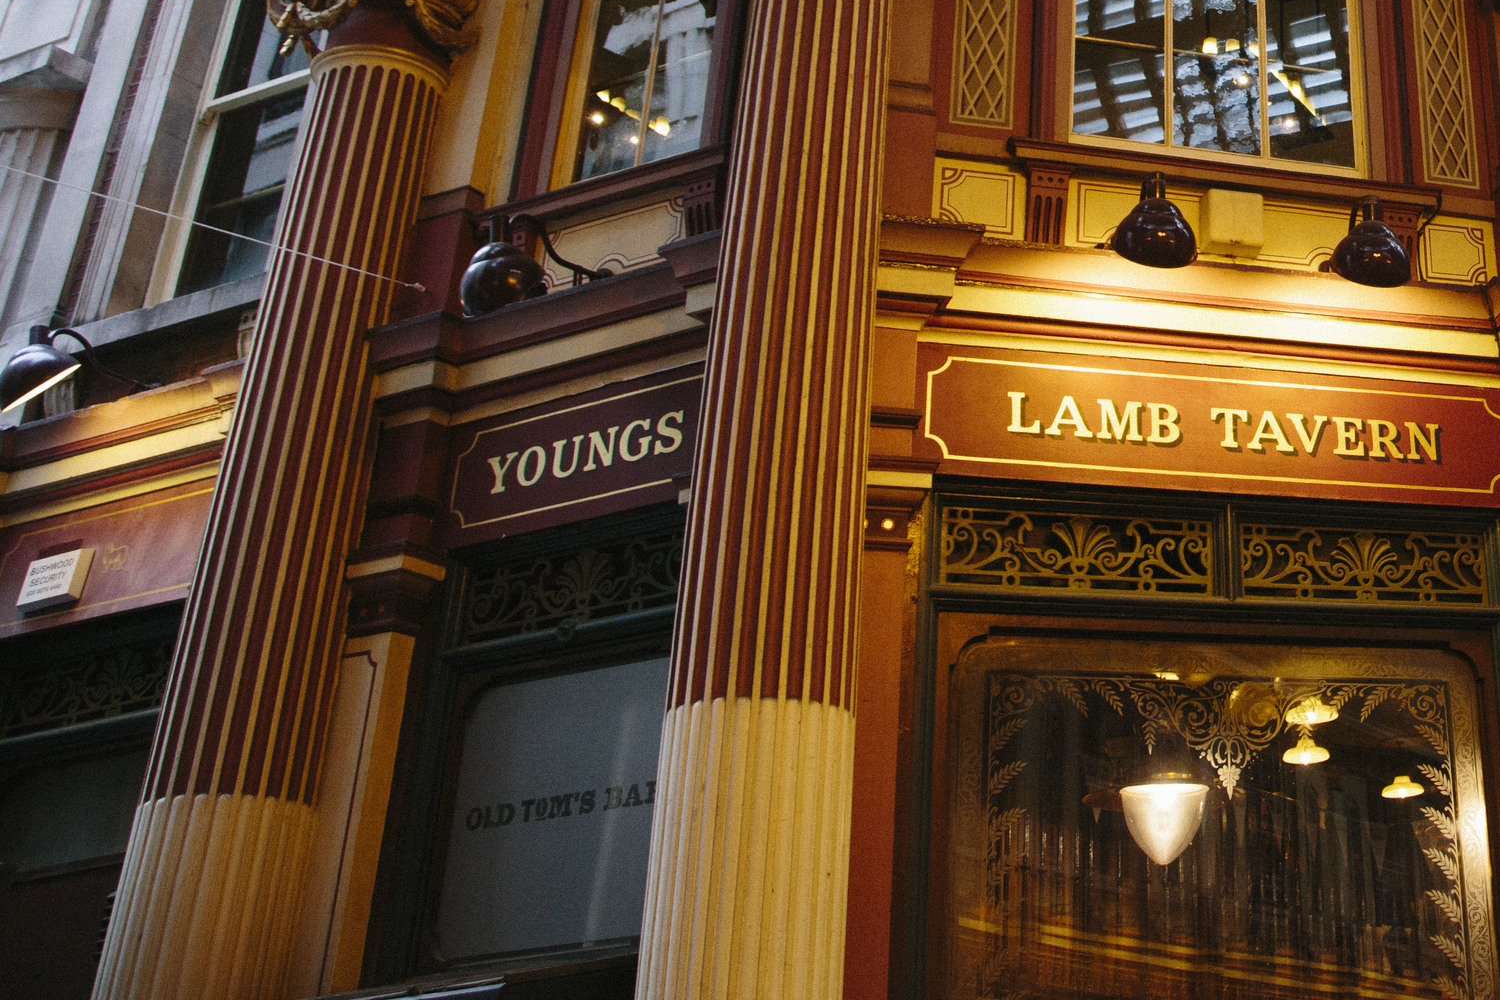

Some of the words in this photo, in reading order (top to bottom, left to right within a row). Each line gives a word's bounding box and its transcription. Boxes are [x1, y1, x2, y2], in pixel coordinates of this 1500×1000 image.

[1006, 391, 1183, 445] LAMB
[1210, 406, 1442, 462] TAVERN
[486, 409, 685, 495] YOUNGS
[29, 557, 74, 577] BUSHWOOD
[29, 571, 67, 588] SECURITY
[465, 802, 516, 832] OLD
[521, 789, 596, 822] TOM'S
